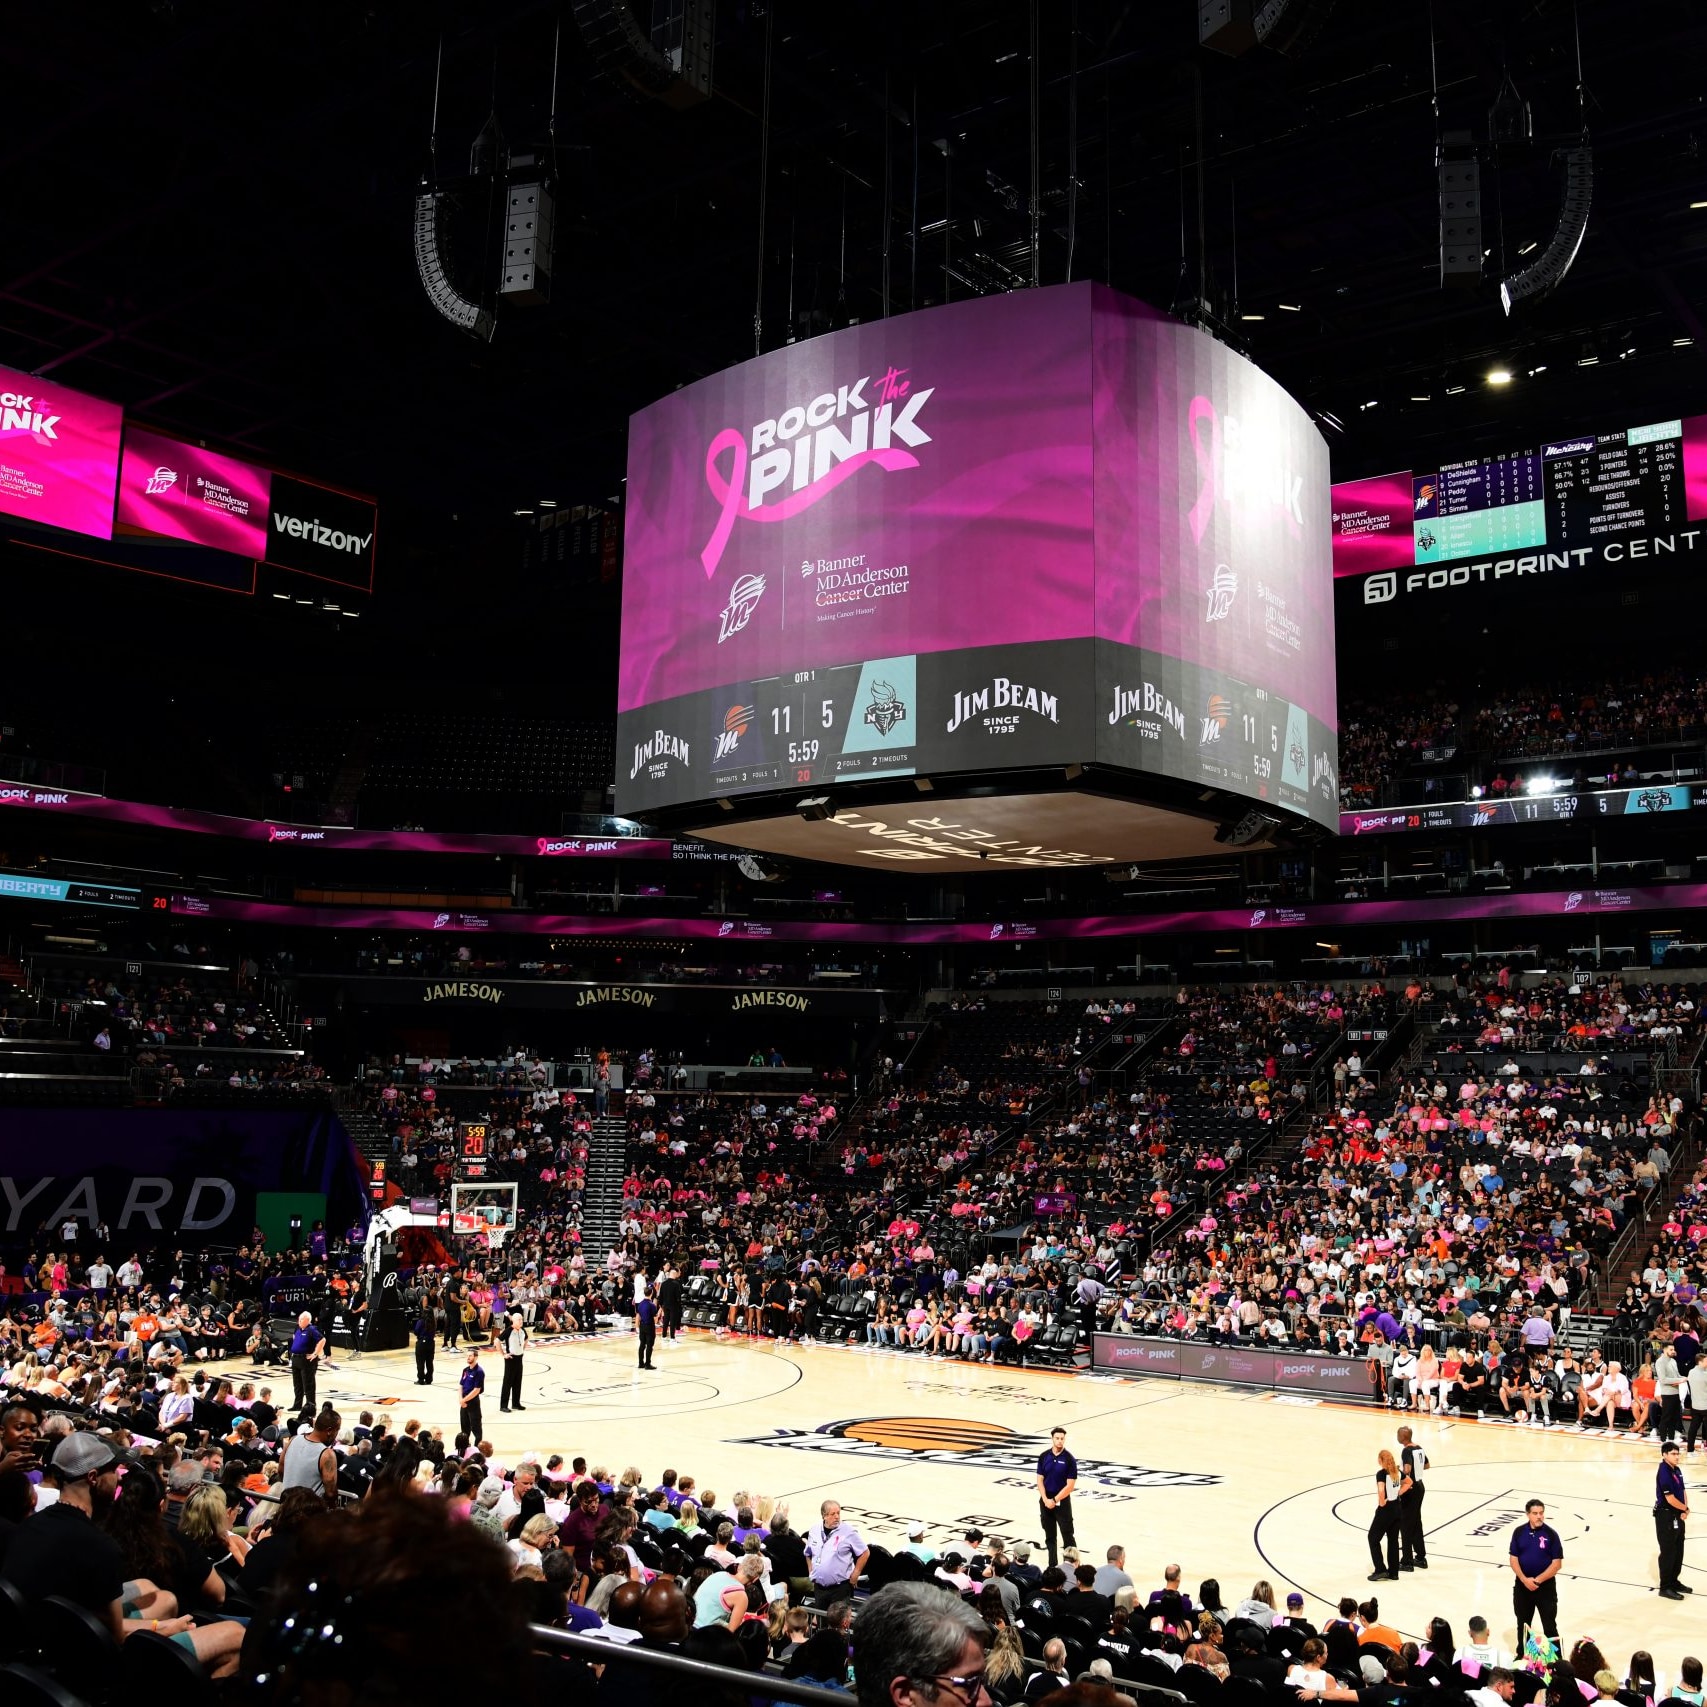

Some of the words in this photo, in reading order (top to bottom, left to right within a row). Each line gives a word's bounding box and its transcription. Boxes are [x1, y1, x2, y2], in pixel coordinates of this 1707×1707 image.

[752, 376, 870, 455] ROCK
[873, 366, 911, 421] the
[1597, 434, 1611, 443] TEAM
[1611, 432, 1626, 441] STATS
[749, 387, 936, 511] PINK
[1553, 461, 1573, 470] 57.1%
[1598, 452, 1611, 461] FIELD
[1611, 450, 1628, 459] GOALS
[1655, 442, 1675, 452] 28.6%
[1440, 461, 1464, 472] INDIVIDUAL
[1464, 459, 1478, 468] STATS
[1604, 460, 1628, 470] POINTERS
[1655, 453, 1676, 462] 25.0%
[1447, 475, 1481, 488] Cunningham
[1555, 481, 1574, 490] 50.0%
[1598, 473, 1610, 482] FREE
[1610, 470, 1631, 480] THROWS
[1658, 463, 1675, 471] 0.0%
[205, 480, 230, 494] Banner
[1448, 487, 1466, 496] Peddy
[1605, 491, 1626, 501] ASSISTS
[203, 496, 228, 509] Cancer
[227, 503, 248, 516] Center
[1449, 504, 1468, 513] Simms
[1602, 501, 1630, 511] TURNOVERS
[1341, 510, 1368, 520] Banner
[1589, 515, 1607, 524] POINTS
[1607, 513, 1616, 521] OFF
[1616, 509, 1644, 520] TURNOVERS
[274, 512, 362, 554] verizon
[1341, 526, 1366, 536] Cancer
[1367, 521, 1391, 531] Center
[1590, 524, 1609, 534] SECOND
[1609, 521, 1628, 531] CHANCE
[1628, 519, 1646, 528] POINTS
[817, 554, 866, 574] Banner
[1406, 548, 1594, 592] FOOTPRINT
[1604, 530, 1707, 562] CENT
[816, 588, 863, 607] Cancer
[864, 581, 910, 599] Center
[817, 614, 836, 623] Making
[836, 609, 855, 619] Cancer
[794, 672, 810, 684] QTR
[811, 670, 815, 681] 1
[946, 690, 989, 734] JIM
[993, 677, 1060, 724] BEAM
[1108, 684, 1141, 725] JIM
[1143, 682, 1185, 740] BEAM
[771, 705, 791, 735] 11
[822, 700, 833, 728] 5
[983, 715, 1020, 726] SINCE
[988, 724, 1016, 734] 1795
[1136, 719, 1162, 732] SINCE
[1140, 729, 1159, 740] 1795
[1243, 714, 1255, 744] 11
[1271, 725, 1277, 752] 5
[630, 738, 655, 779] JIM
[654, 729, 691, 767] BEAM
[788, 739, 819, 763] 5:59
[648, 763, 669, 775] SINCE
[836, 761, 842, 770] 2
[842, 759, 861, 768] FOULS
[872, 756, 878, 766] 2
[879, 754, 908, 764] TIMEOUTS
[1254, 754, 1270, 779] 5:59
[650, 770, 666, 780] 1795
[716, 775, 738, 784] TIMEOUTS
[742, 772, 747, 781] 3
[752, 770, 768, 779] FOULS
[773, 769, 777, 778] 1
[797, 769, 811, 782] 20
[0, 789, 30, 799] OCK
[35, 794, 69, 804] PINK
[1428, 810, 1443, 818] FOULS
[1525, 804, 1538, 819] 11
[1553, 797, 1578, 812] 5:59
[1600, 798, 1607, 813] 5
[1361, 816, 1388, 828] ROCK
[1408, 815, 1420, 827] 20
[1429, 818, 1452, 827] TIMEOUTS
[301, 832, 325, 840] PINK
[547, 841, 581, 852] ROCK
[586, 841, 618, 852] PINK
[673, 844, 706, 852] BENEFIT.
[689, 853, 712, 861] THINK
[79, 889, 84, 897] 2
[115, 894, 136, 902] TIMEOUTS
[153, 897, 167, 909] 20
[129, 963, 139, 974] 121
[1576, 974, 1589, 983] 102
[424, 983, 503, 1004] JAMESON
[576, 988, 654, 1008] JAMESON
[1050, 989, 1060, 998] 124
[731, 992, 810, 1012] JAMESON
[468, 1126, 486, 1137] 5:59
[465, 1137, 484, 1155] 20
[0, 1176, 237, 1232] YARD
[1116, 1347, 1144, 1357] ROCK
[1148, 1349, 1176, 1359] PINK
[1283, 1364, 1316, 1374] ROCK
[1320, 1366, 1351, 1377] PINK
